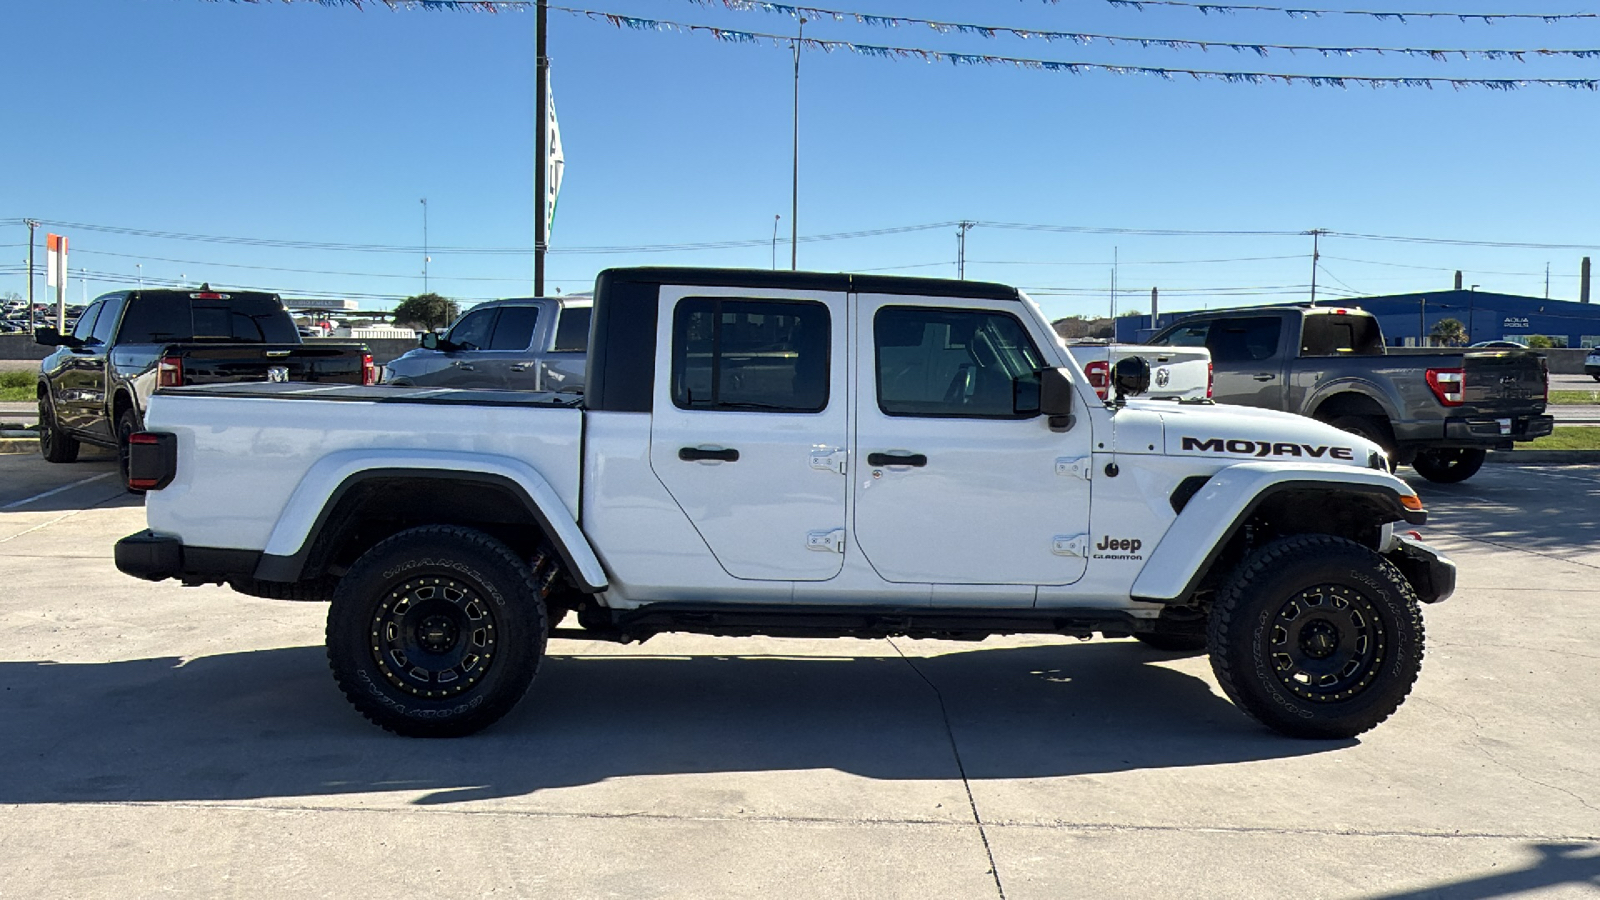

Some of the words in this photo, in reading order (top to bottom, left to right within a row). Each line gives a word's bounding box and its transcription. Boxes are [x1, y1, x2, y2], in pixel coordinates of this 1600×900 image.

[1182, 437, 1354, 461] MOJAVE
[1097, 535, 1142, 554] Jeep
[382, 557, 506, 607] WRANGLER
